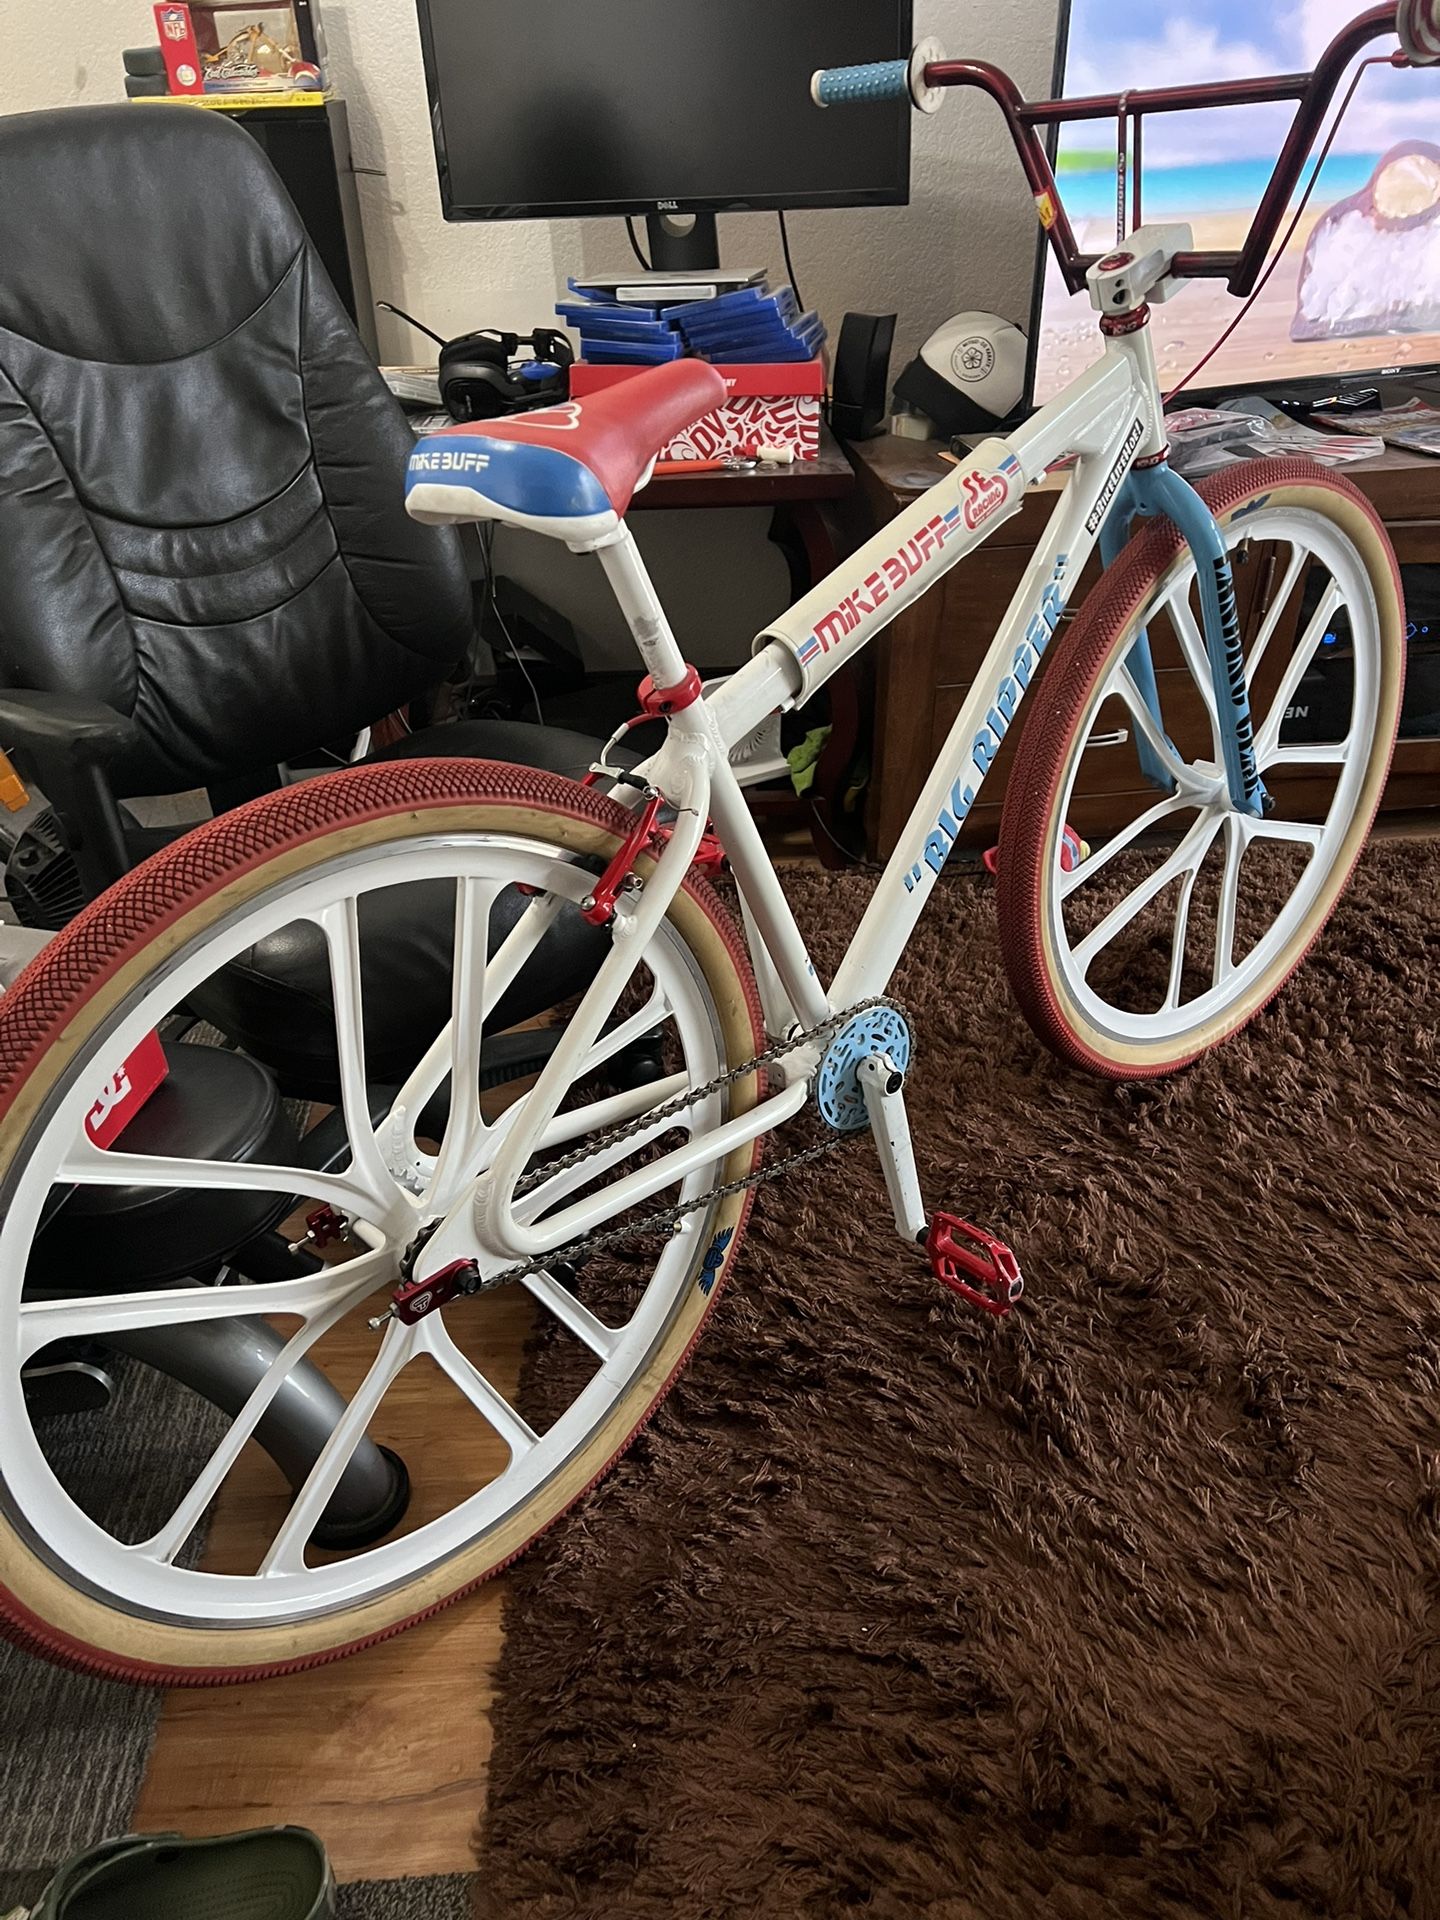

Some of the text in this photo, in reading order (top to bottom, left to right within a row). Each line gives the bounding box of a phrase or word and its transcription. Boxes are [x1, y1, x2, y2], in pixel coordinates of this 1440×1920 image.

[165, 22, 185, 38] NFL
[657, 201, 678, 210] DELL
[962, 471, 994, 504] SE
[972, 487, 1001, 519] RACING
